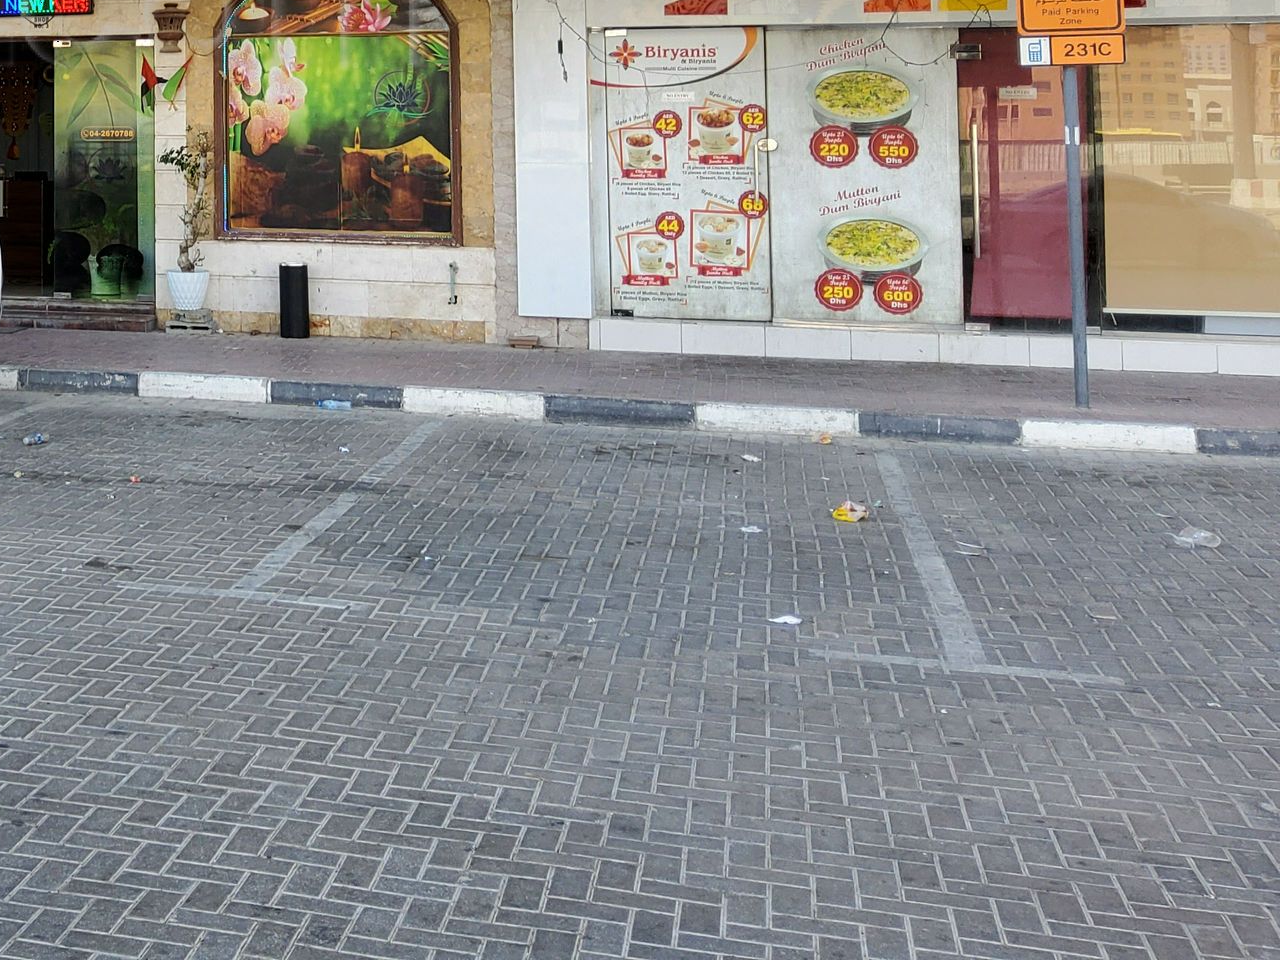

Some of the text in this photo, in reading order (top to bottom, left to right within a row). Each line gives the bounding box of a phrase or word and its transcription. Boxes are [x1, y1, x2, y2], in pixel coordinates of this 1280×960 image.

[1041, 7, 1100, 17] Paid Parking
[1060, 17, 1082, 25] Zone
[644, 43, 717, 61] Biryanis
[819, 37, 864, 56] Chicken
[1063, 42, 1113, 58] 231C
[805, 41, 887, 72] Dum Biryani
[655, 118, 677, 131] 42
[742, 111, 764, 125] 62
[89, 129, 135, 138] 04-2670788
[819, 143, 849, 156] 220
[878, 145, 910, 157] 550
[834, 184, 879, 202] Mutton
[742, 198, 764, 210] 68
[818, 190, 902, 216] Dum Biryani
[657, 219, 680, 232] 44
[823, 286, 854, 299] 250
[883, 291, 914, 302] 600
